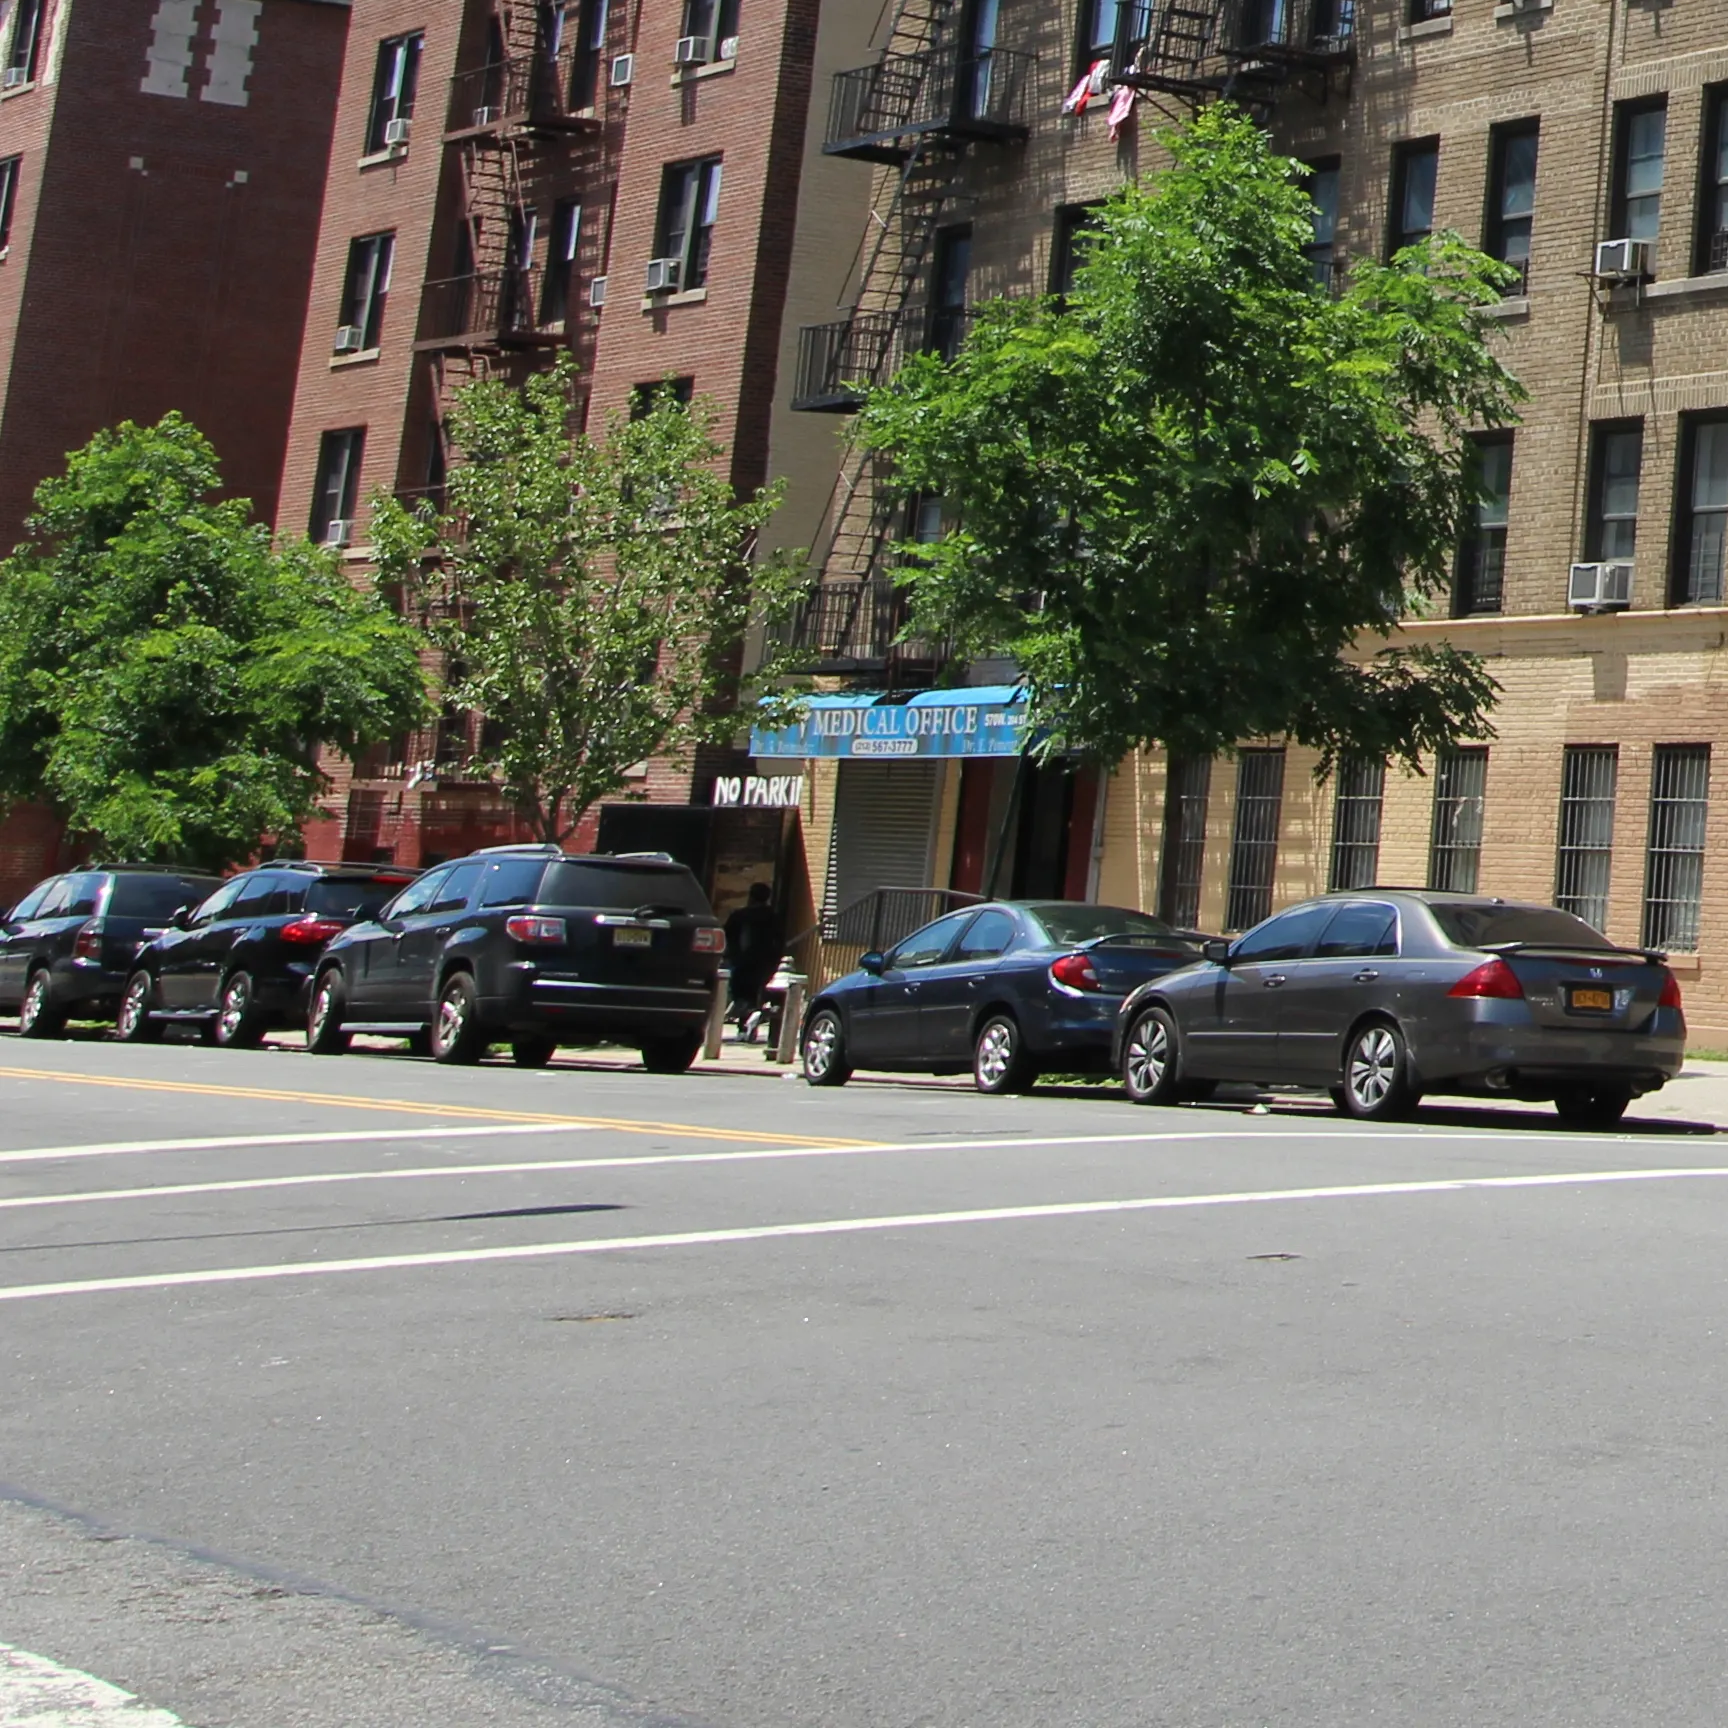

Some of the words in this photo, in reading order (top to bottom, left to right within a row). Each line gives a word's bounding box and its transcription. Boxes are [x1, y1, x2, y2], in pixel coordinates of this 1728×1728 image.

[813, 708, 901, 736] MEDICAL
[905, 706, 978, 735] OFFICE
[714, 775, 741, 806] NO
